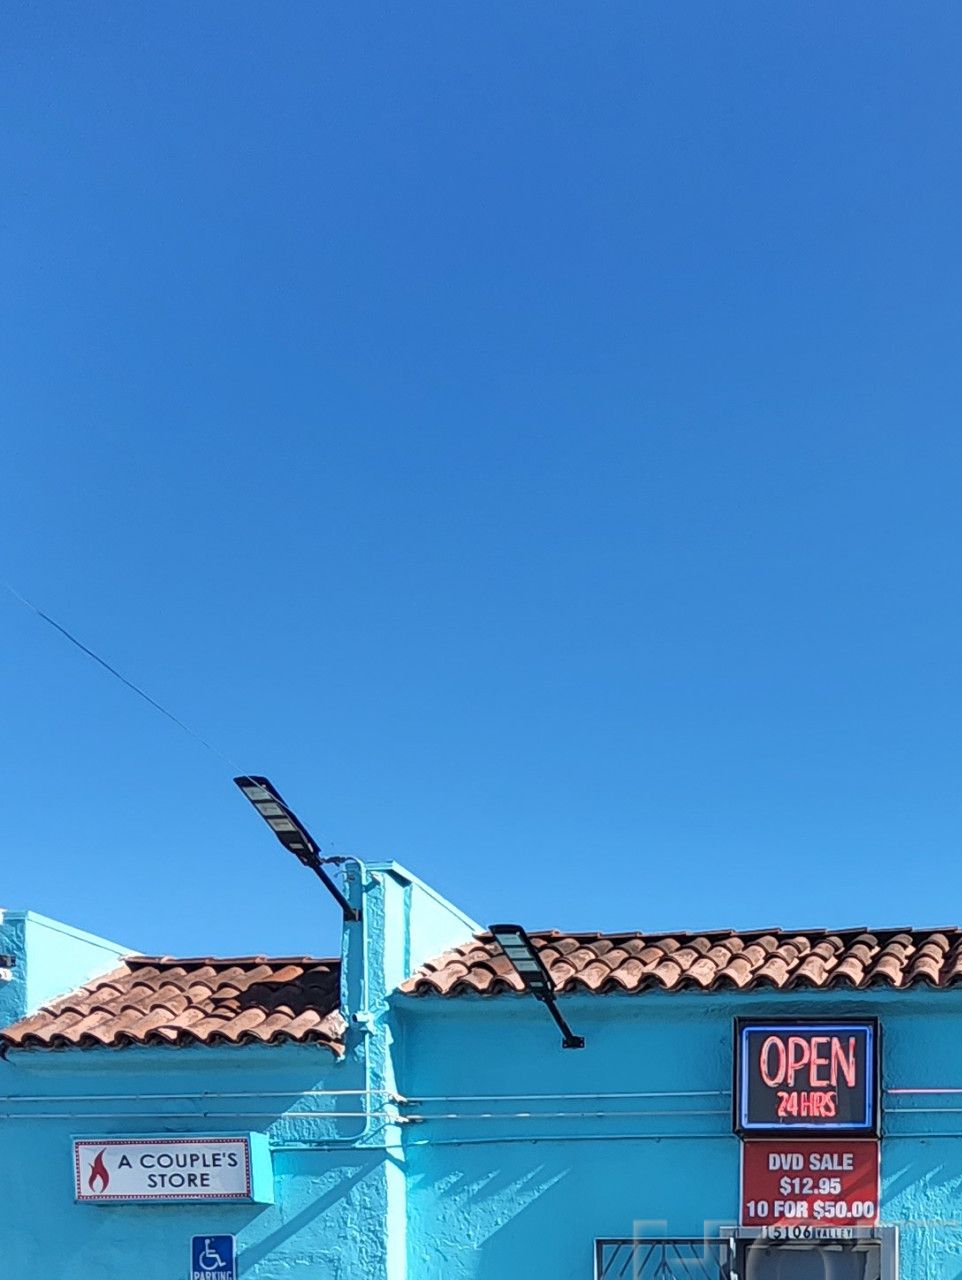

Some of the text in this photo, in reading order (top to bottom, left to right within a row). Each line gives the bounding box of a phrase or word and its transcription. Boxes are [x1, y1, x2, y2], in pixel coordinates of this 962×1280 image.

[759, 1036, 856, 1088] OPEN
[776, 1091, 836, 1117] 24 HRS
[118, 1152, 238, 1169] A COUPLE'S
[768, 1153, 854, 1171] DVD SALE
[147, 1173, 211, 1188] STORE
[779, 1176, 842, 1196] $12.95
[747, 1200, 875, 1220] 10 FOR $50.00
[817, 1228, 853, 1239] VALLEY
